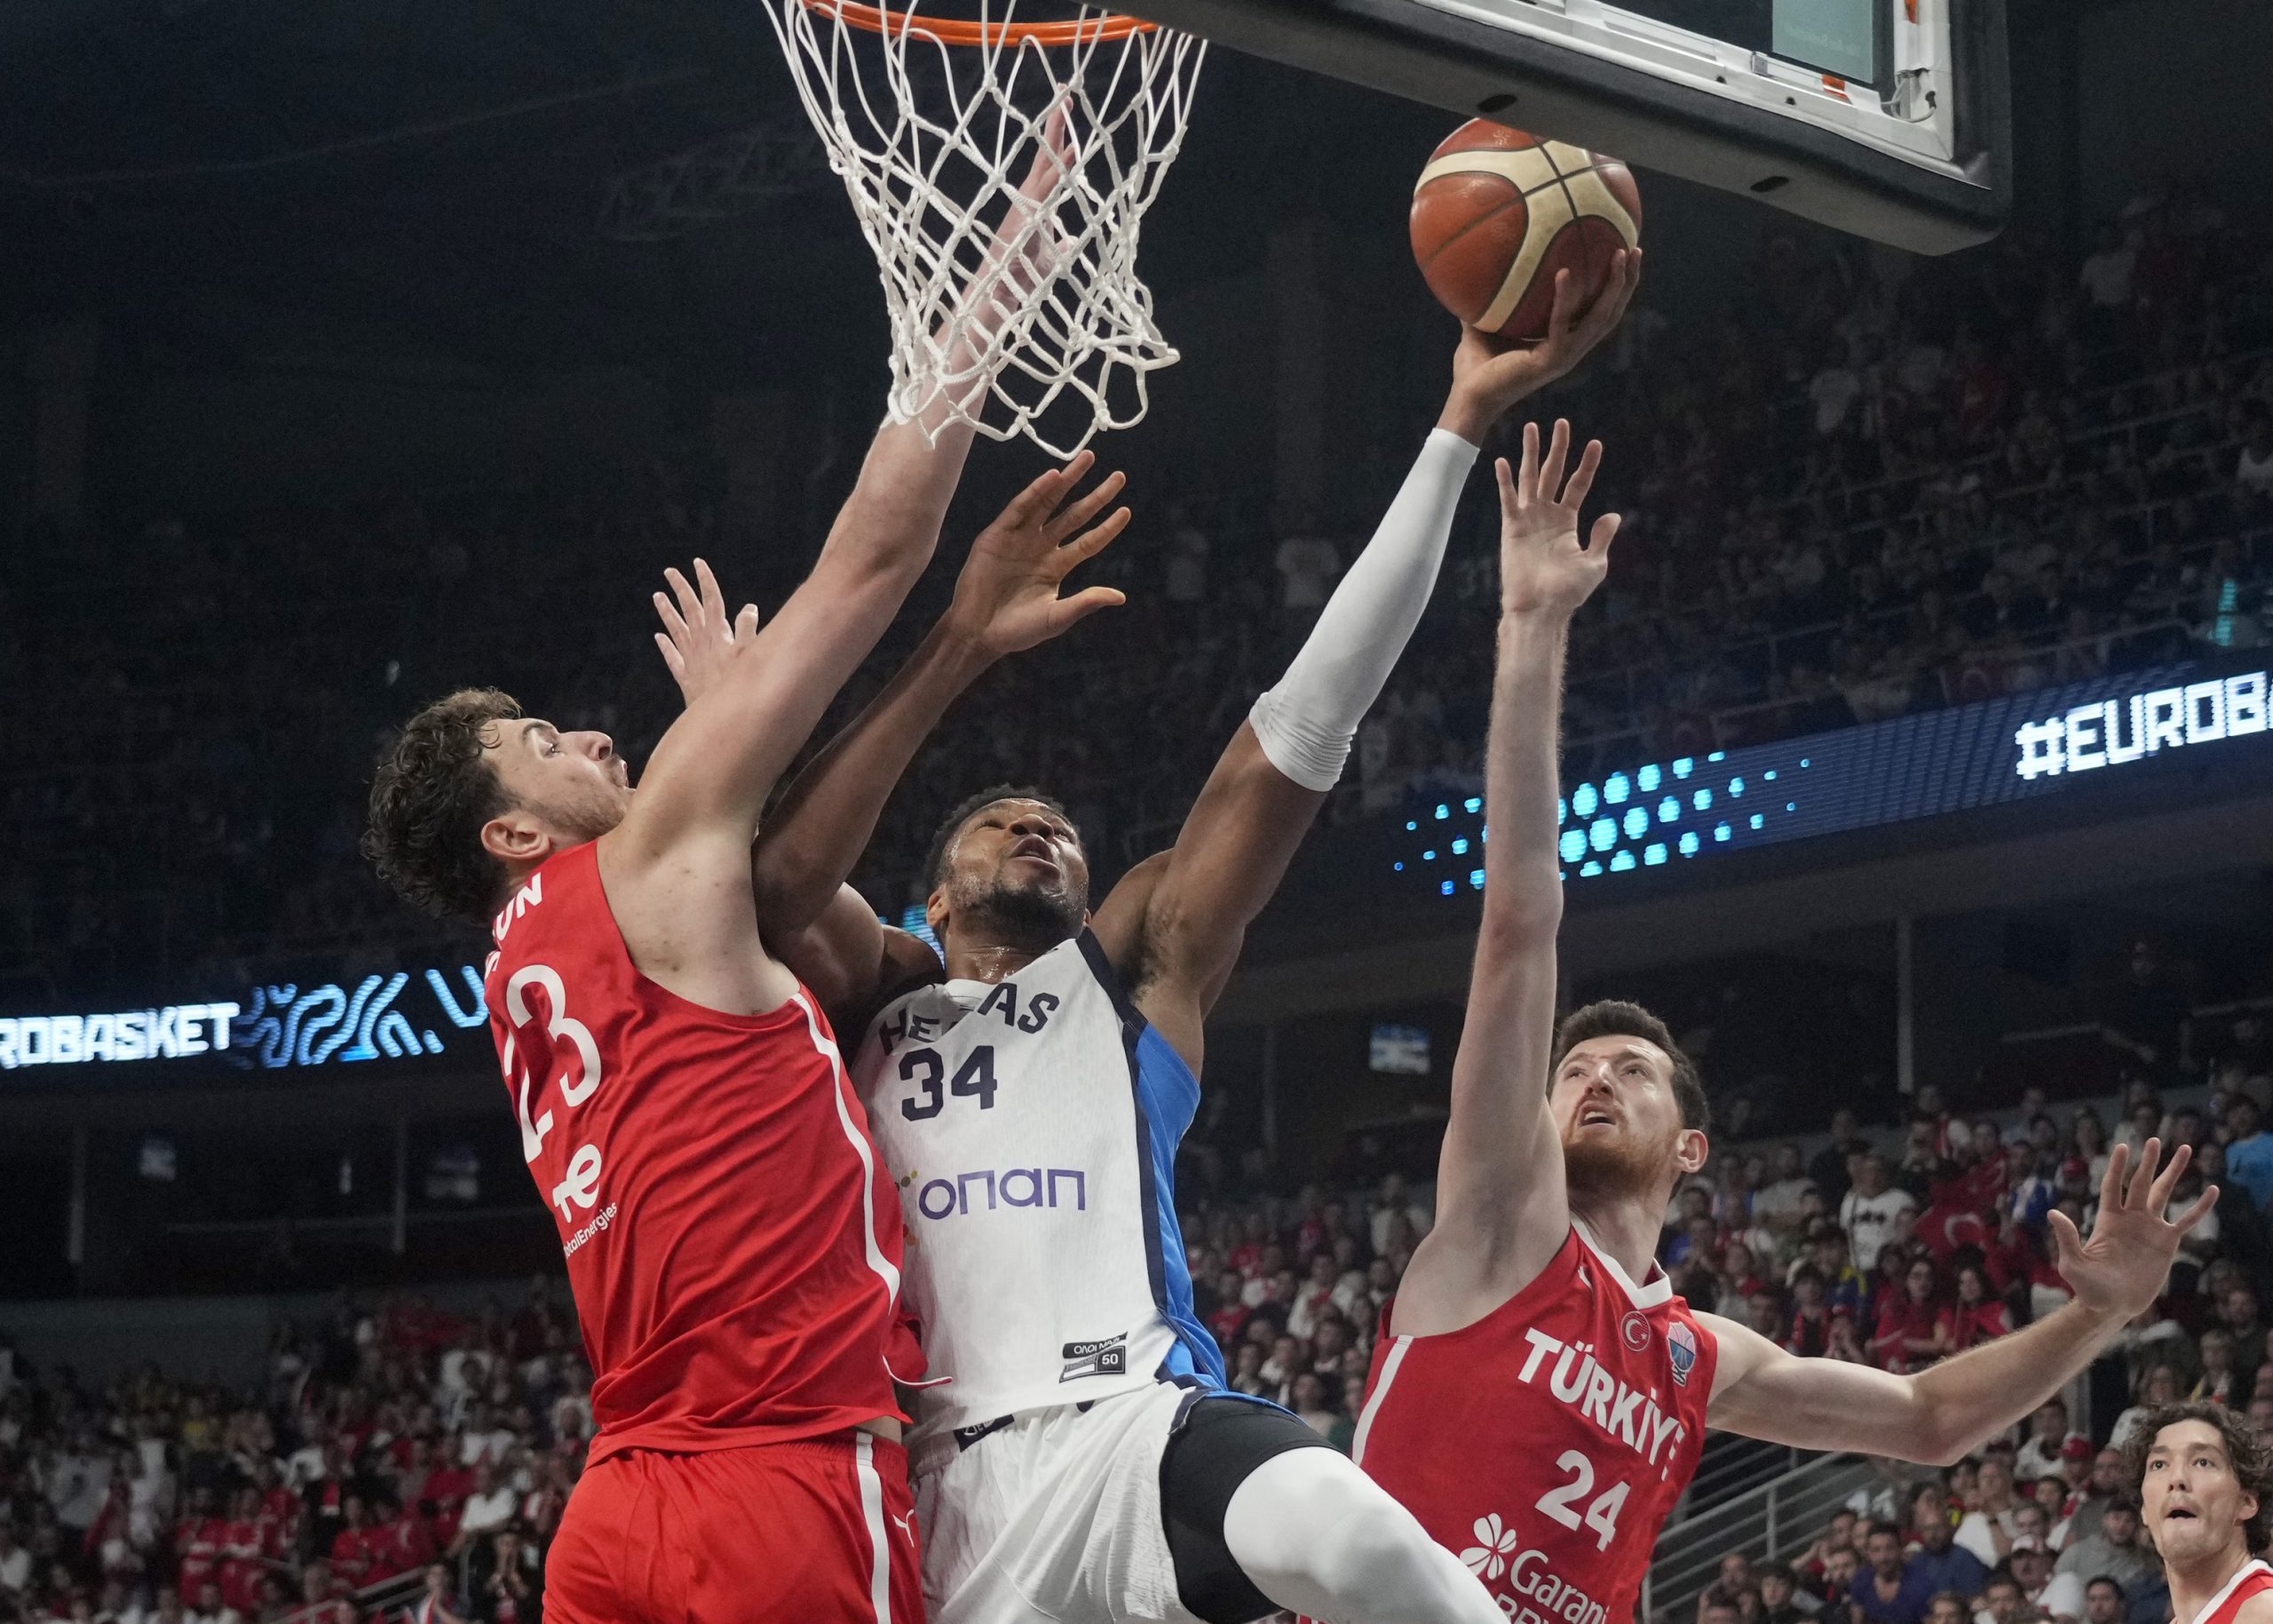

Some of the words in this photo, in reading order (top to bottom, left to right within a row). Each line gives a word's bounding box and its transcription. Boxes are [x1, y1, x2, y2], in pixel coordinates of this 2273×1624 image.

[2015, 671, 2273, 780] #EUROB
[879, 983, 1059, 1056] HEAS
[899, 1045, 998, 1121] 34
[1102, 1353, 1119, 1366] 50
[1534, 1449, 1631, 1552] 24
[1510, 1549, 1610, 1624] Garan
